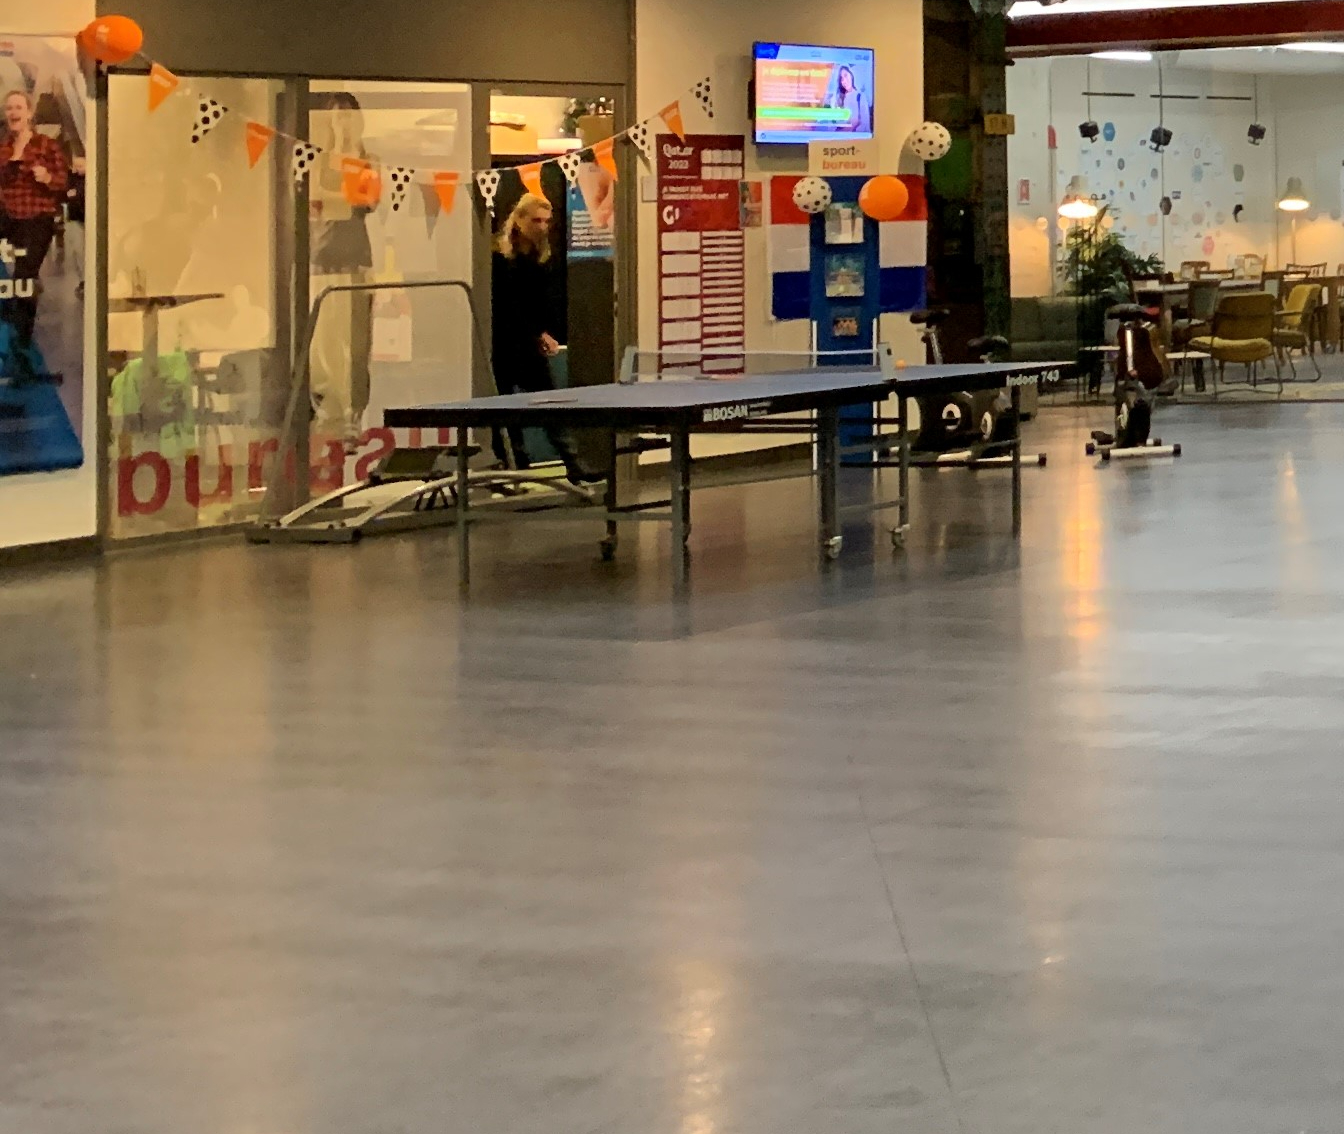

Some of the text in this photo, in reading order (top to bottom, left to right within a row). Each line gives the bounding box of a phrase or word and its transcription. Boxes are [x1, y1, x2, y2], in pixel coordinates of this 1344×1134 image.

[822, 160, 866, 170] bureau
[1006, 373, 1039, 387] Indoor
[712, 404, 749, 421] BOSAN
